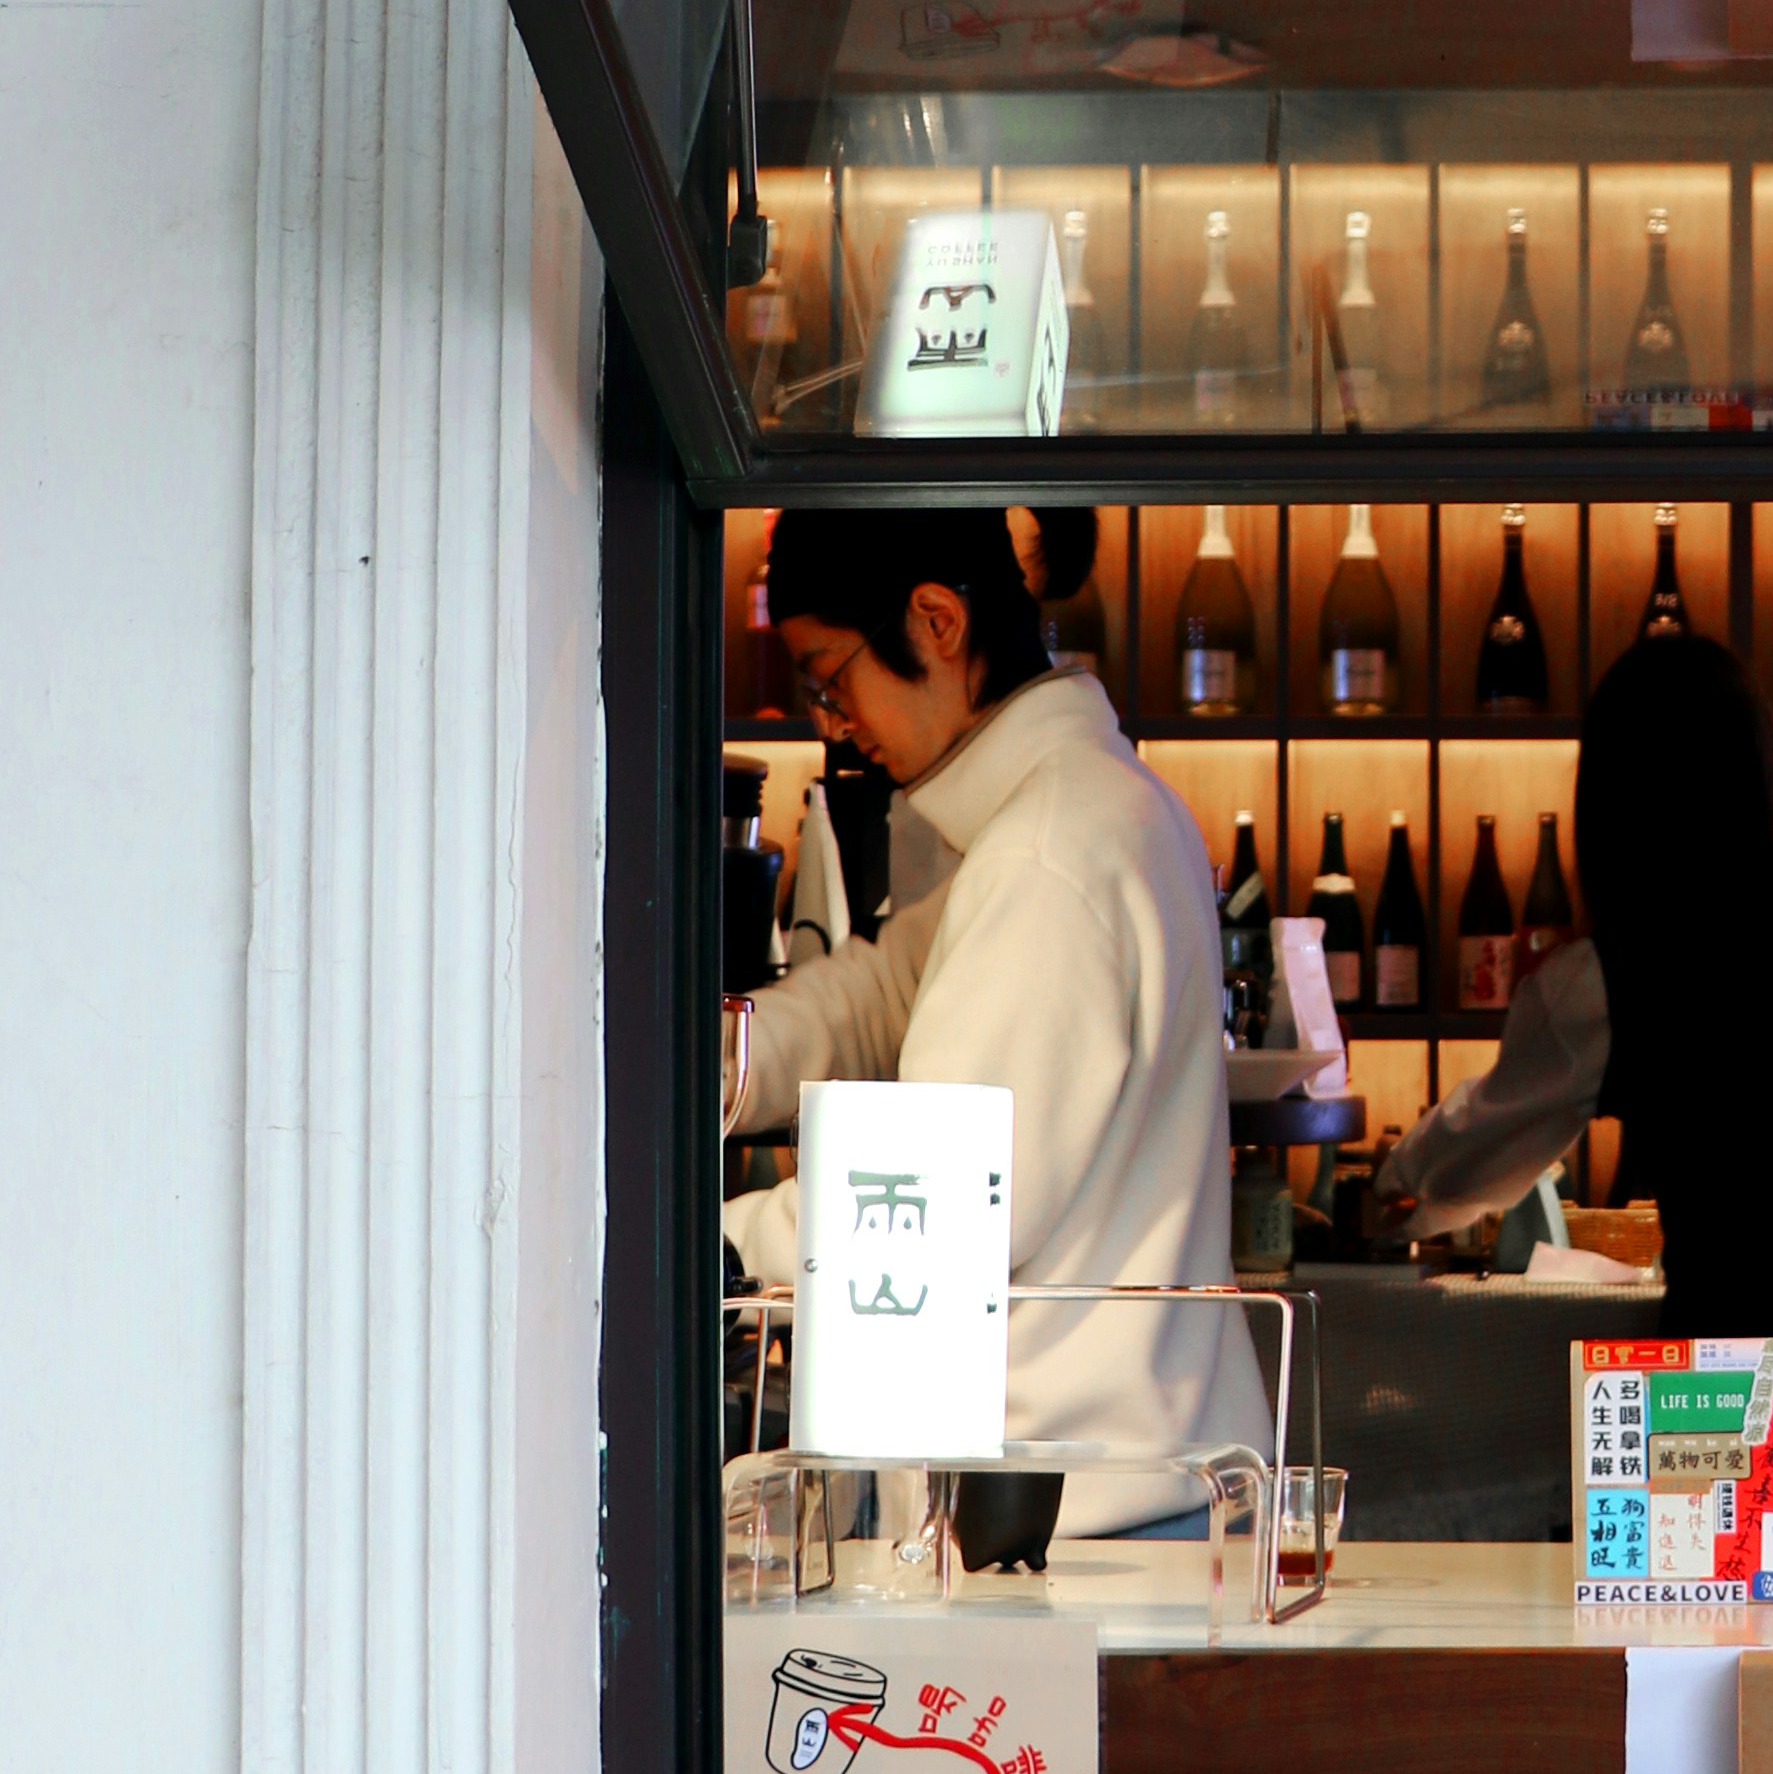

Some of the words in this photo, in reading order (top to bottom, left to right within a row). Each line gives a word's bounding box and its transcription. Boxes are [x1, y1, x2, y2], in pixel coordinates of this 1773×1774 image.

[1591, 1380, 1613, 1476] 人生无解
[1619, 1380, 1642, 1476] 多喝拿铁
[1660, 1395, 1689, 1409] LIFE
[1696, 1395, 1709, 1408] IS
[1716, 1394, 1745, 1408] GOOD
[1577, 1584, 1745, 1602] PEACE&LOVE
